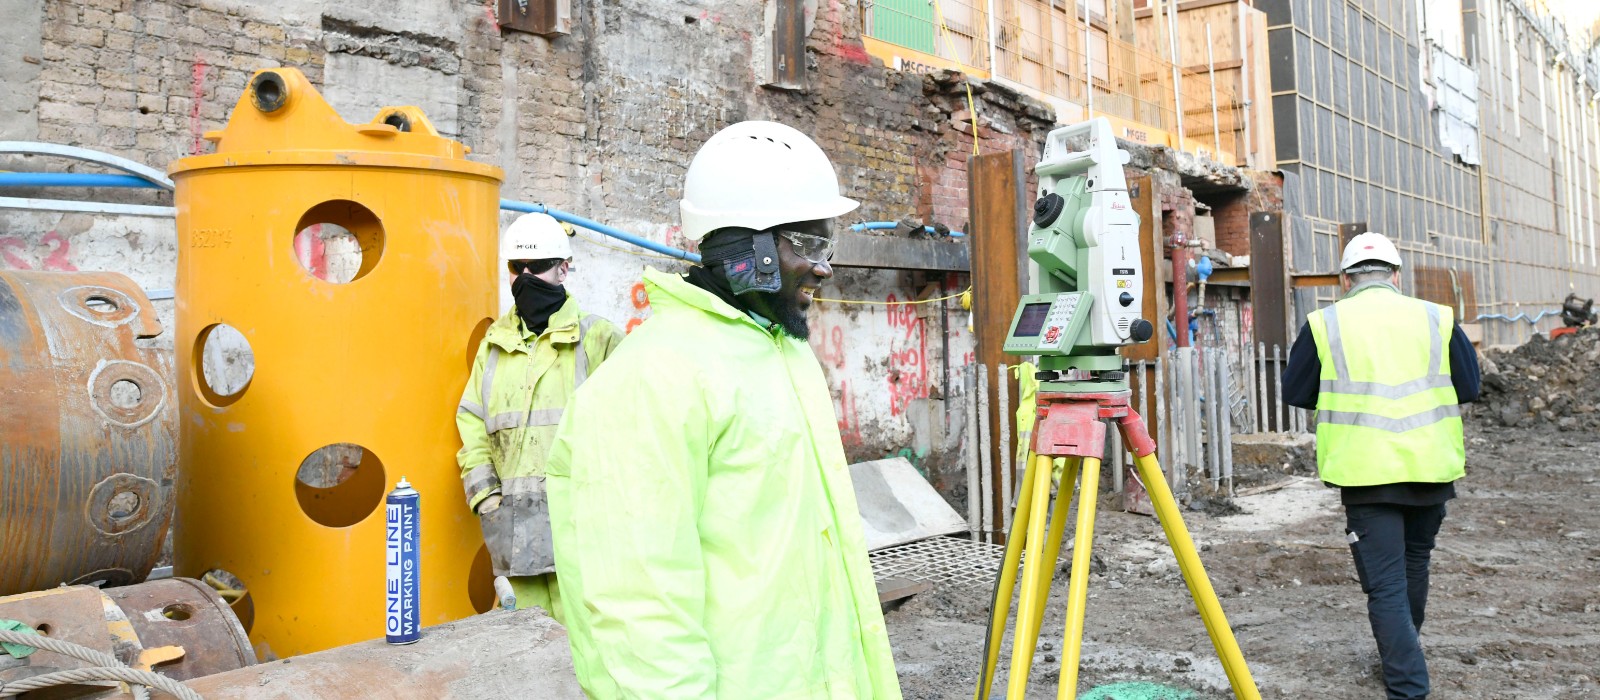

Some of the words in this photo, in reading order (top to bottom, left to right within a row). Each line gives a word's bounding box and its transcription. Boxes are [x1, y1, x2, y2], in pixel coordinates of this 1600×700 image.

[388, 507, 399, 566] LINE
[403, 504, 413, 553] PAINT
[388, 578, 399, 632] ONE
[403, 559, 413, 635] MARKING
